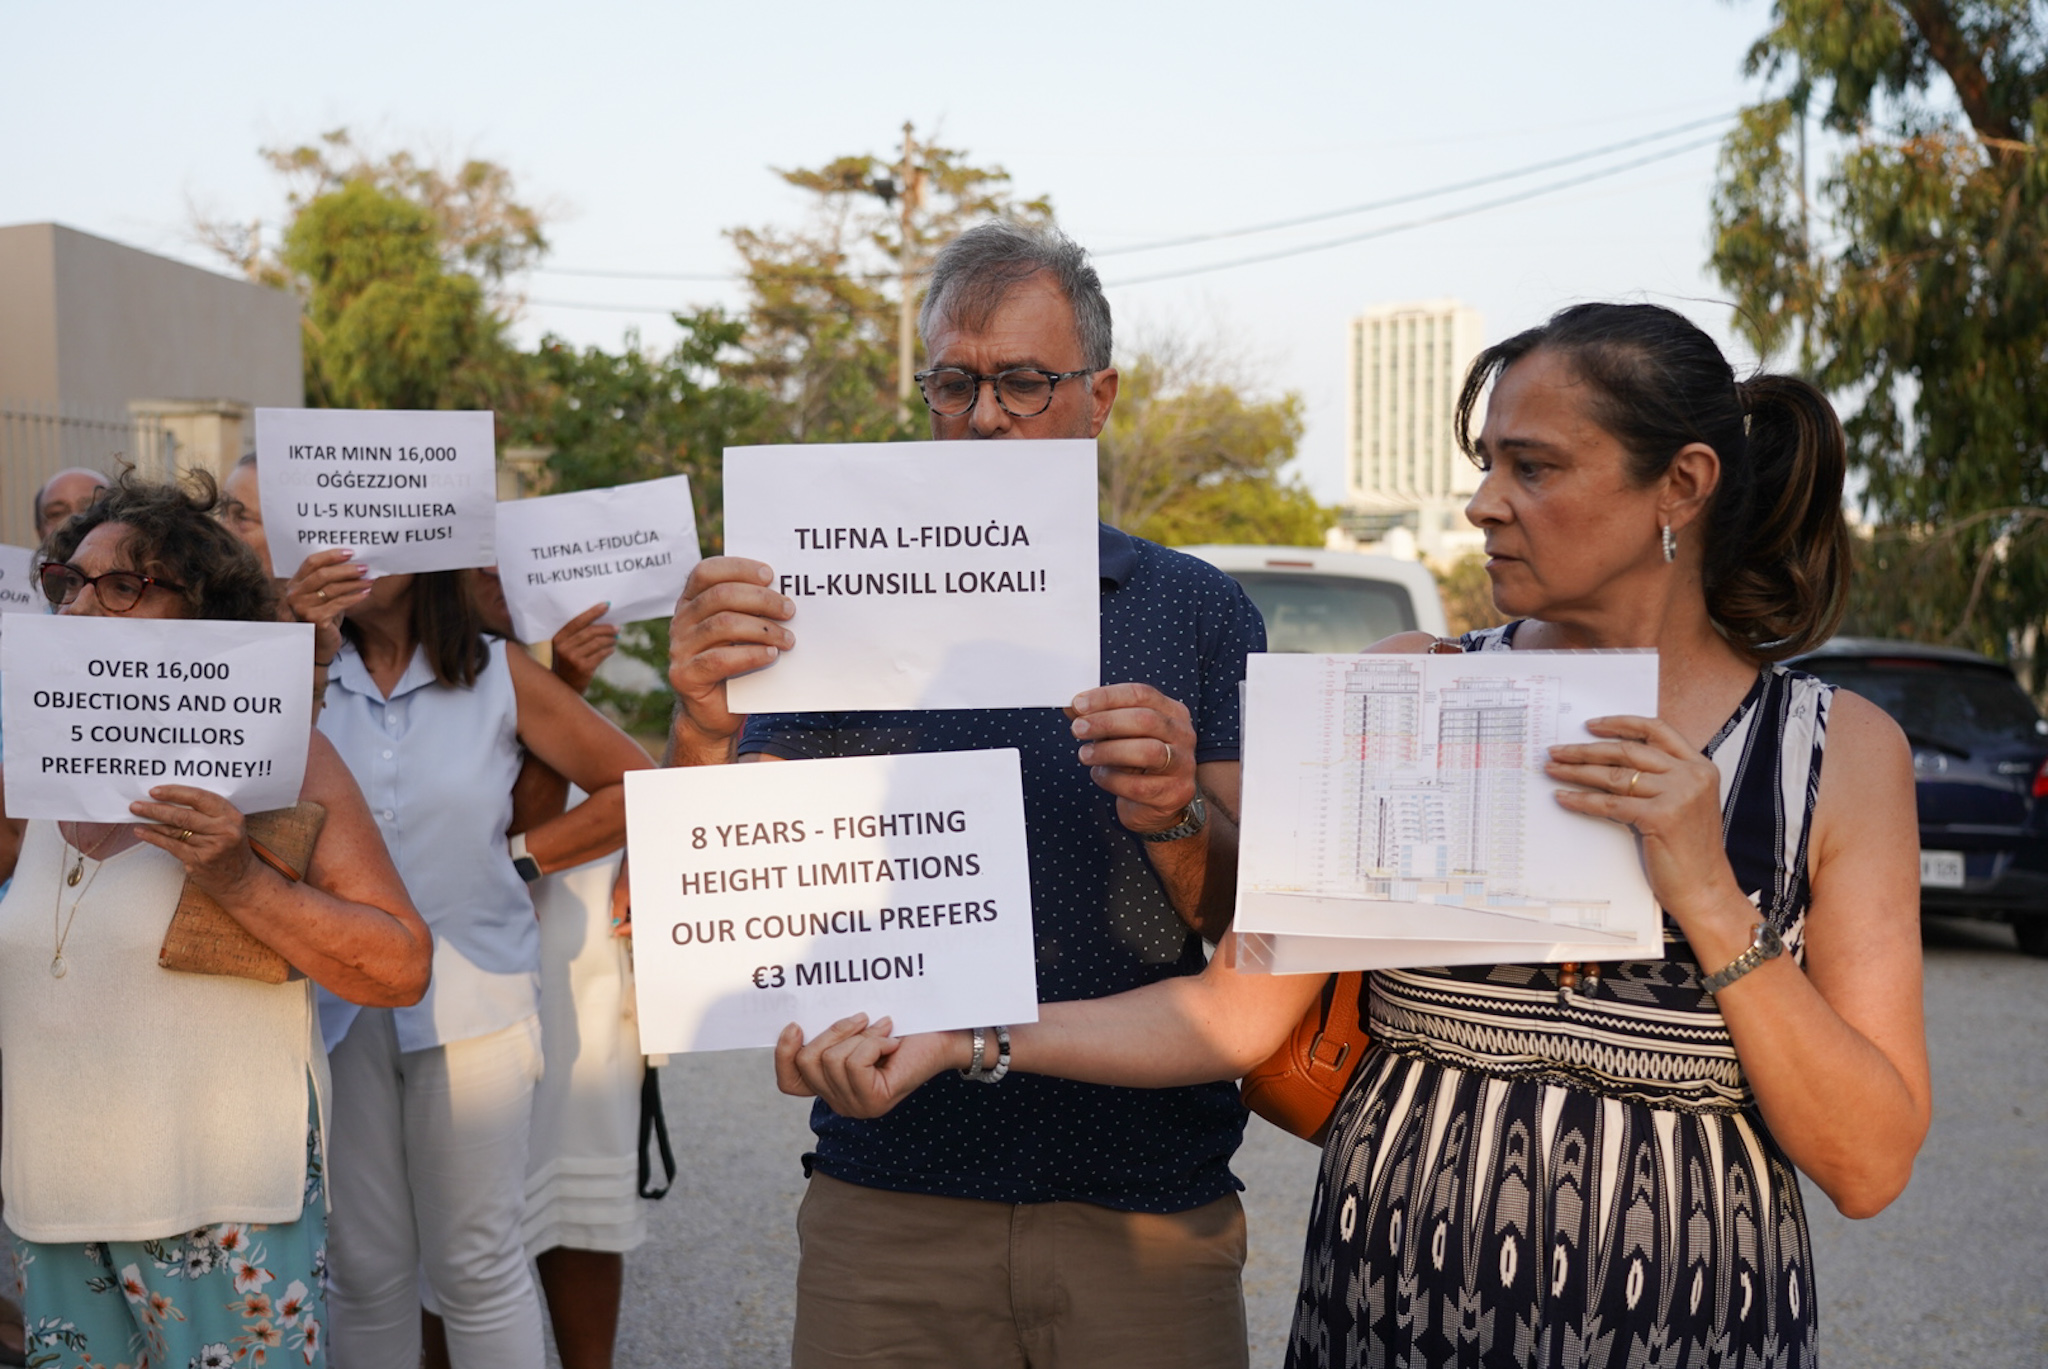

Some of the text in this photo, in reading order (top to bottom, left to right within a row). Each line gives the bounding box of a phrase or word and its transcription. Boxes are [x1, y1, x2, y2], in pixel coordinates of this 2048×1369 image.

[289, 445, 457, 464] IKTAR MINN 16,000
[316, 470, 427, 489] OĠĠEZZJONI
[297, 502, 457, 518] U L-5 KUNSILLIERA
[297, 525, 452, 546] PPREFEREW FLUS!
[530, 530, 660, 560] TLIFNA L-FIDUĊJA
[794, 519, 1030, 550] TLIFNA L-FIDUĊJA
[526, 551, 672, 587] FIL-KUNSILL LOKALI!
[780, 569, 1046, 596] FIL-KUNSILL LOKALI!
[0, 588, 30, 604] OUR
[87, 659, 230, 683] OVER 16,000
[33, 690, 282, 714] OBJECTIONS AND OUR
[71, 724, 245, 746] 5 COUNCILLORS
[41, 756, 272, 778] PREFERRED MONEY!!
[691, 826, 708, 850] 8
[715, 819, 806, 848] YEARS
[833, 809, 966, 840] FIGHTING
[681, 852, 981, 896] HEIGHT LIMITATIONS
[671, 899, 998, 946] OUR COUNCIL PREFERS
[751, 952, 924, 990] €3 MILLION!
